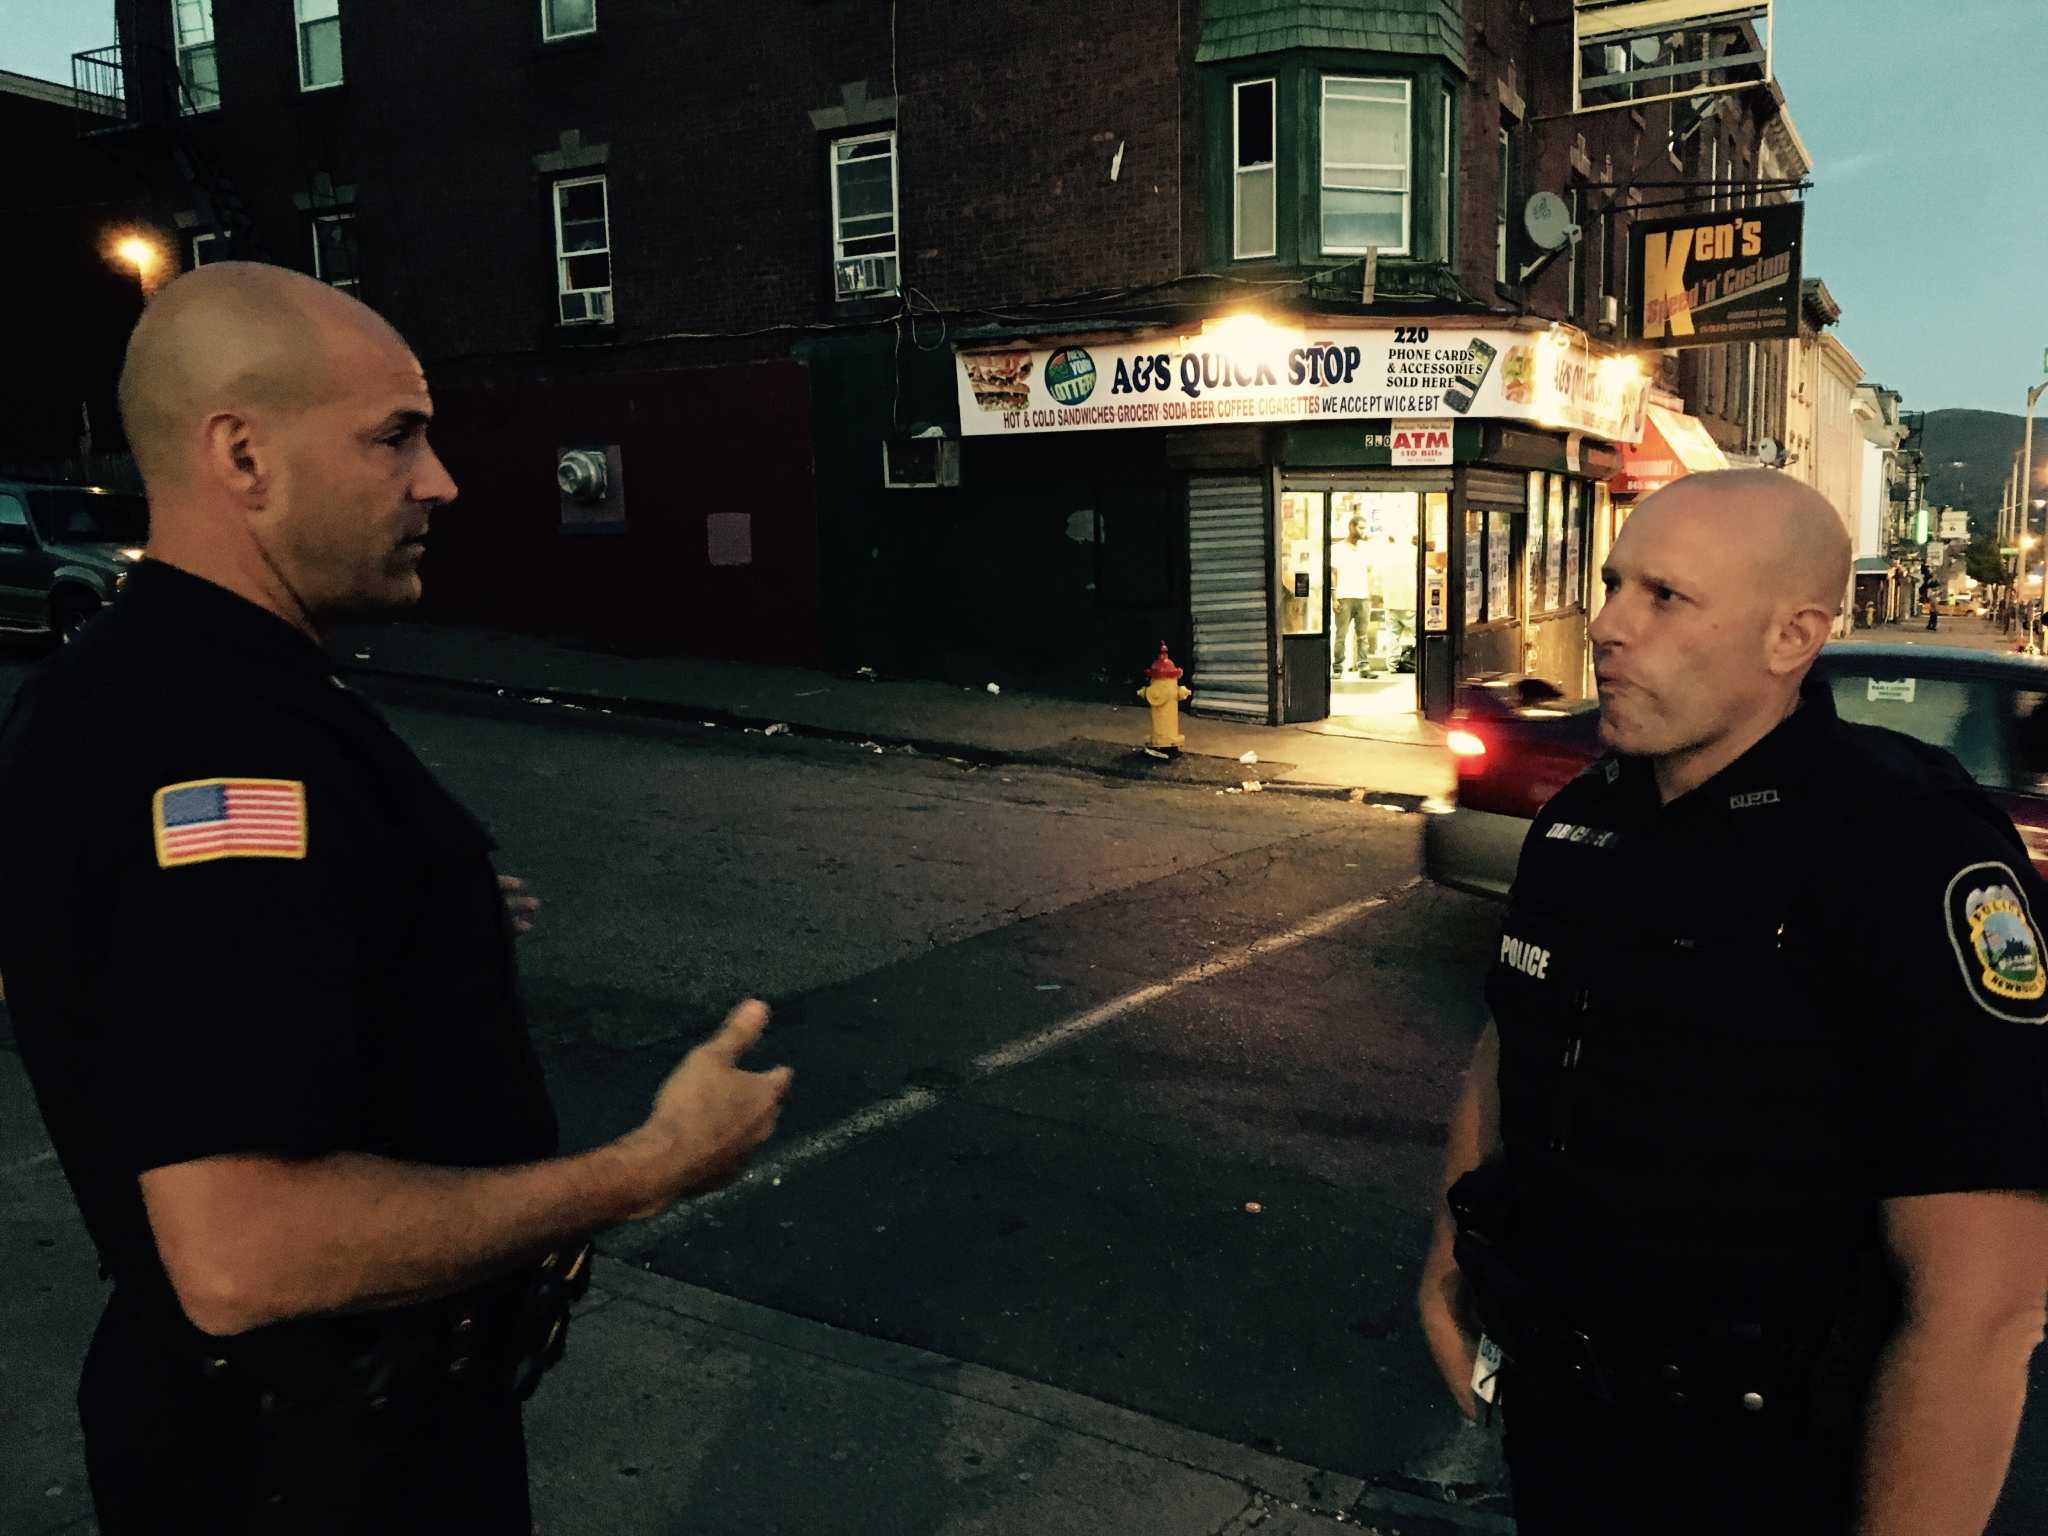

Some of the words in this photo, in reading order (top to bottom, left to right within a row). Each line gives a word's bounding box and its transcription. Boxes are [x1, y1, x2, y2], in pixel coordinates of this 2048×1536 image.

[1643, 217, 1761, 338] Ken's
[1722, 251, 1790, 295] Custom
[1394, 326, 1429, 343] 220
[1388, 348, 1431, 360] PHONE
[1434, 349, 1475, 361] CARDS
[1111, 354, 1171, 395] A&S
[1288, 344, 1361, 386] STOP
[1387, 363, 1396, 374] &
[1400, 363, 1483, 375] ACCESSORIES
[1386, 377, 1419, 388] SOLD
[1422, 377, 1455, 388] HERE
[1003, 411, 1020, 429] HOT
[1023, 411, 1031, 428] &
[1032, 409, 1056, 428] COLD
[1057, 405, 1115, 426] SANDWICHES
[1117, 403, 1160, 422] GROCERY
[1163, 402, 1187, 420] SODA
[1190, 400, 1214, 419] BEER
[1217, 398, 1254, 416] COFFEE
[1258, 395, 1320, 415] CIGARETTES
[1322, 396, 1338, 413] WE
[1339, 395, 1382, 412] ACCEPT
[1365, 435, 1391, 447] 20
[1393, 431, 1449, 448] ATM
[1501, 934, 1550, 980] POLICE
